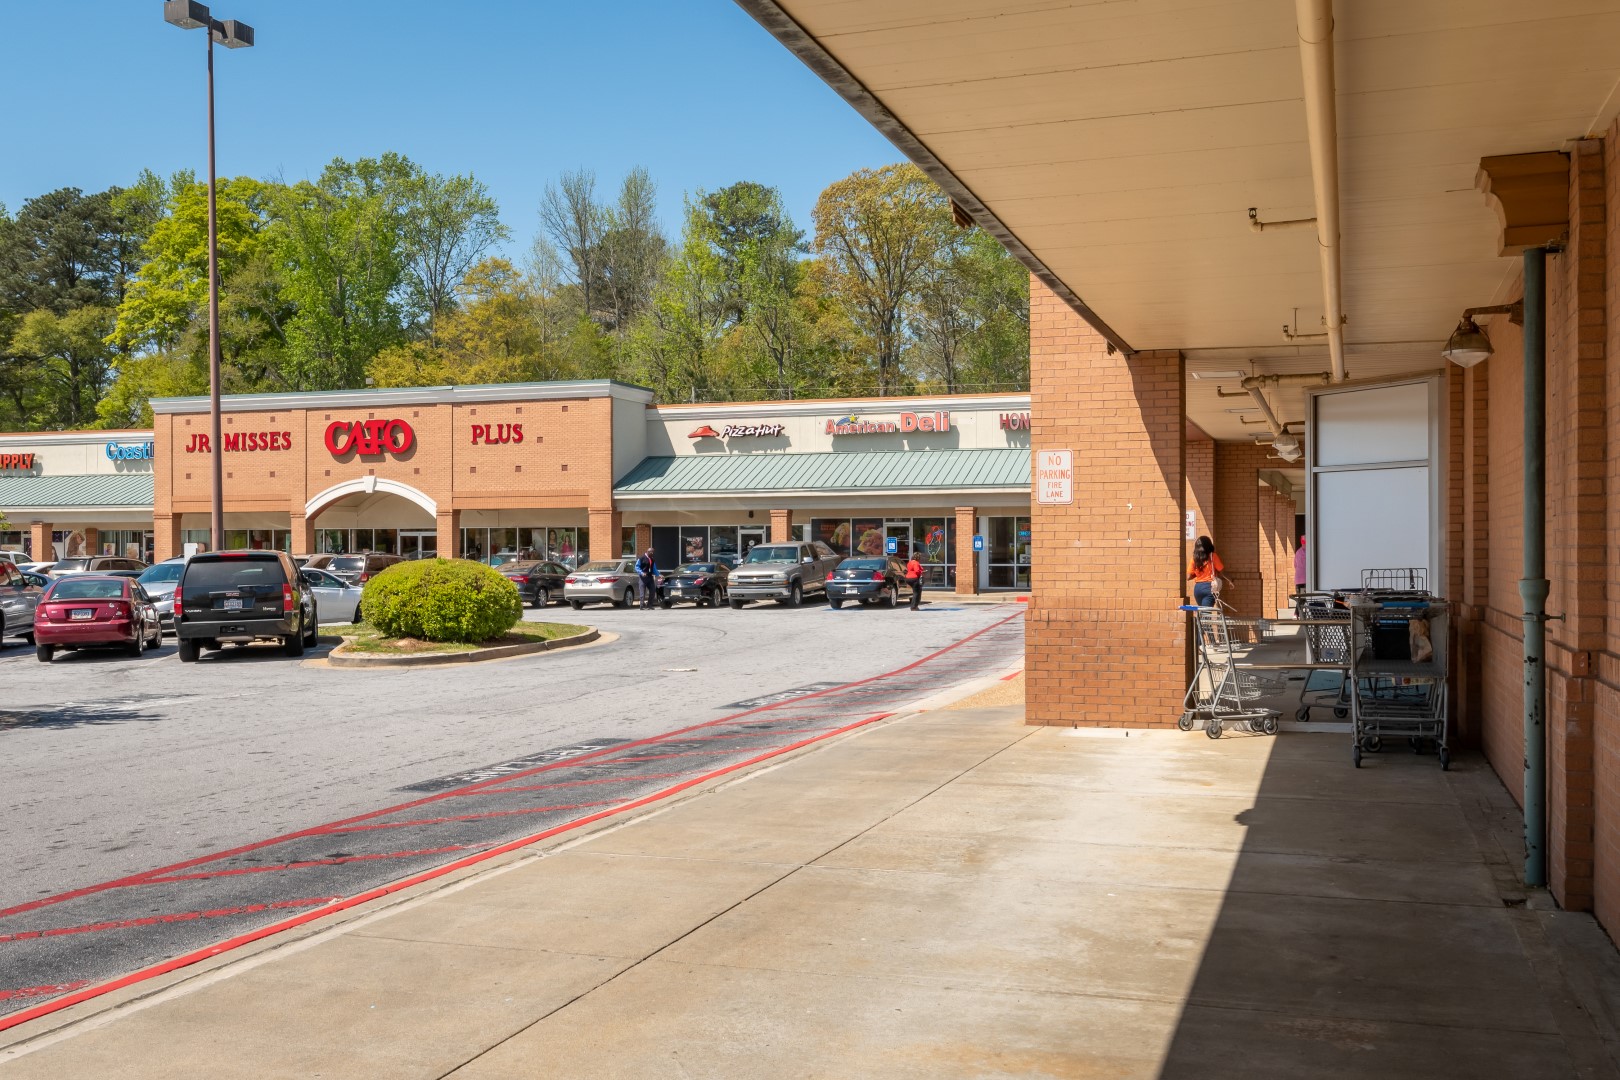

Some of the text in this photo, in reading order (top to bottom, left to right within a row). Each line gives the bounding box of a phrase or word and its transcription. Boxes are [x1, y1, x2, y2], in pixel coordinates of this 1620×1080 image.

[825, 411, 950, 435] American Deli
[224, 431, 292, 453] MISSES
[324, 418, 413, 455] CATO
[470, 423, 523, 445] PLUS
[1048, 455, 1062, 466] NO
[1040, 469, 1071, 480] PARKING
[1047, 481, 1063, 489] FIRE
[1046, 490, 1064, 498] LANE
